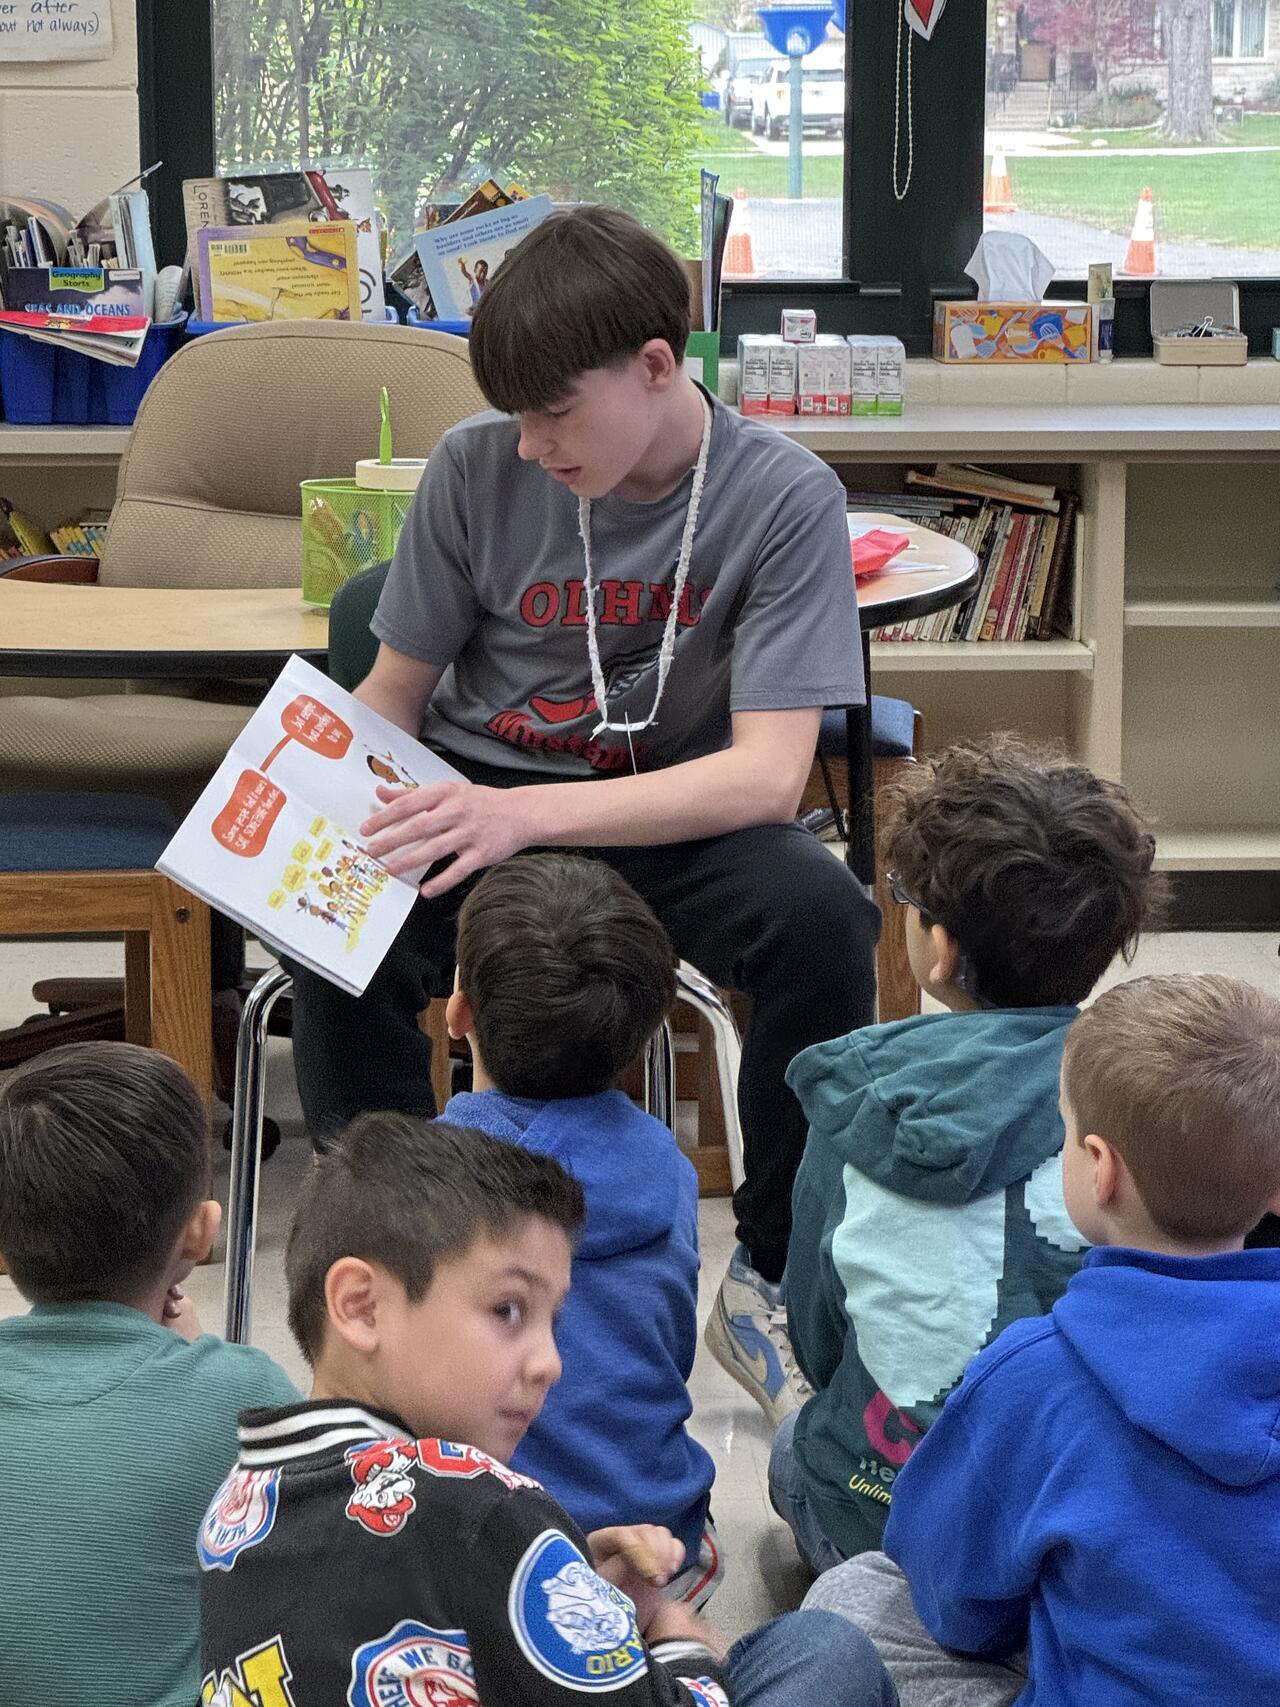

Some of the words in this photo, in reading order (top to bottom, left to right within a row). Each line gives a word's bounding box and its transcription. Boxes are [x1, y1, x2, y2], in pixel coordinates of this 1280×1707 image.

[0, 4, 16, 14] er
[31, 0, 79, 14] after
[26, 19, 44, 32] not
[49, 11, 100, 36] always)
[85, 303, 131, 317] OCEANS
[519, 579, 712, 628] OLHM
[848, 1474, 892, 1505] Unlim
[398, 1646, 438, 1669] WE
